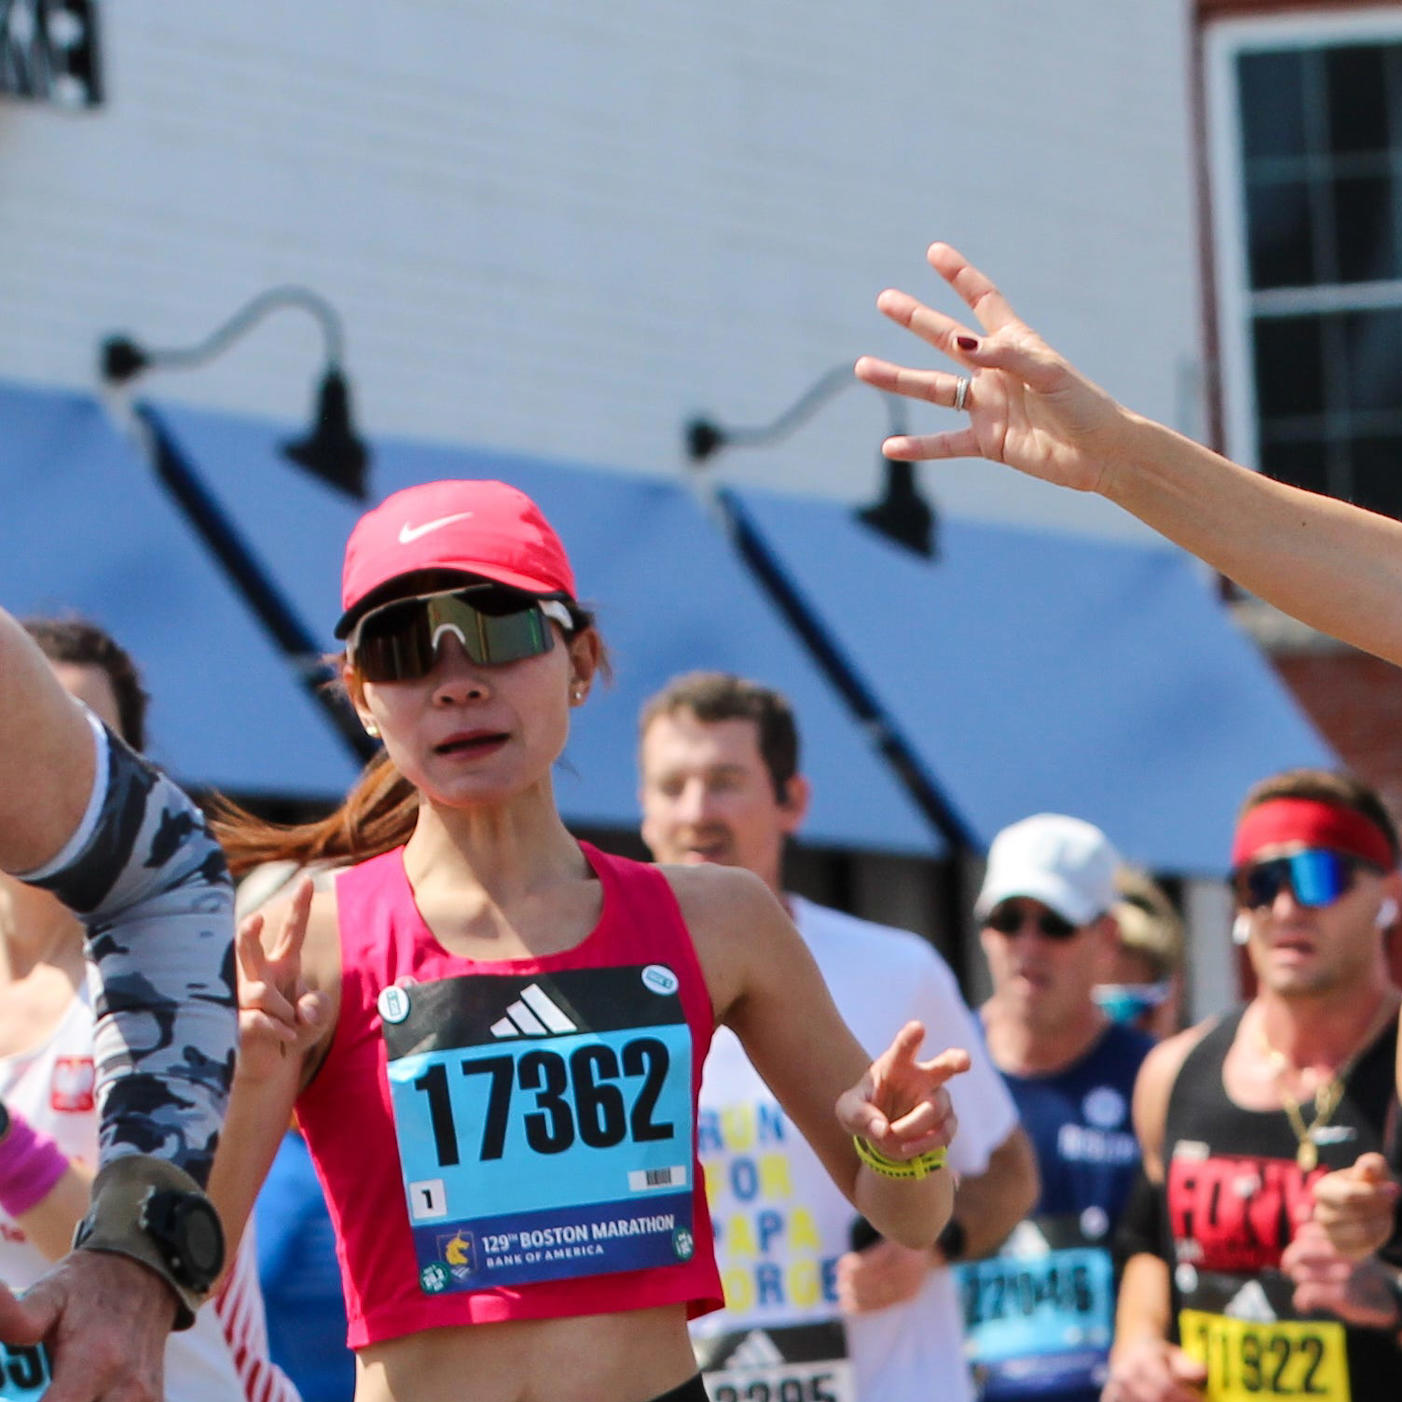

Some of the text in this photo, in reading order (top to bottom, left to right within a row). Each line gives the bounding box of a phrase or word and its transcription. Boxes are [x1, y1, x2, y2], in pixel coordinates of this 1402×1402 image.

[415, 1037, 674, 1167] 17362
[699, 1103, 784, 1153] RUN
[421, 1189, 434, 1209] 1
[481, 1213, 675, 1253] 129TH BOSTON MARATHON
[486, 1244, 605, 1268] BANK OF AMERICA
[725, 1259, 840, 1316] ORGE
